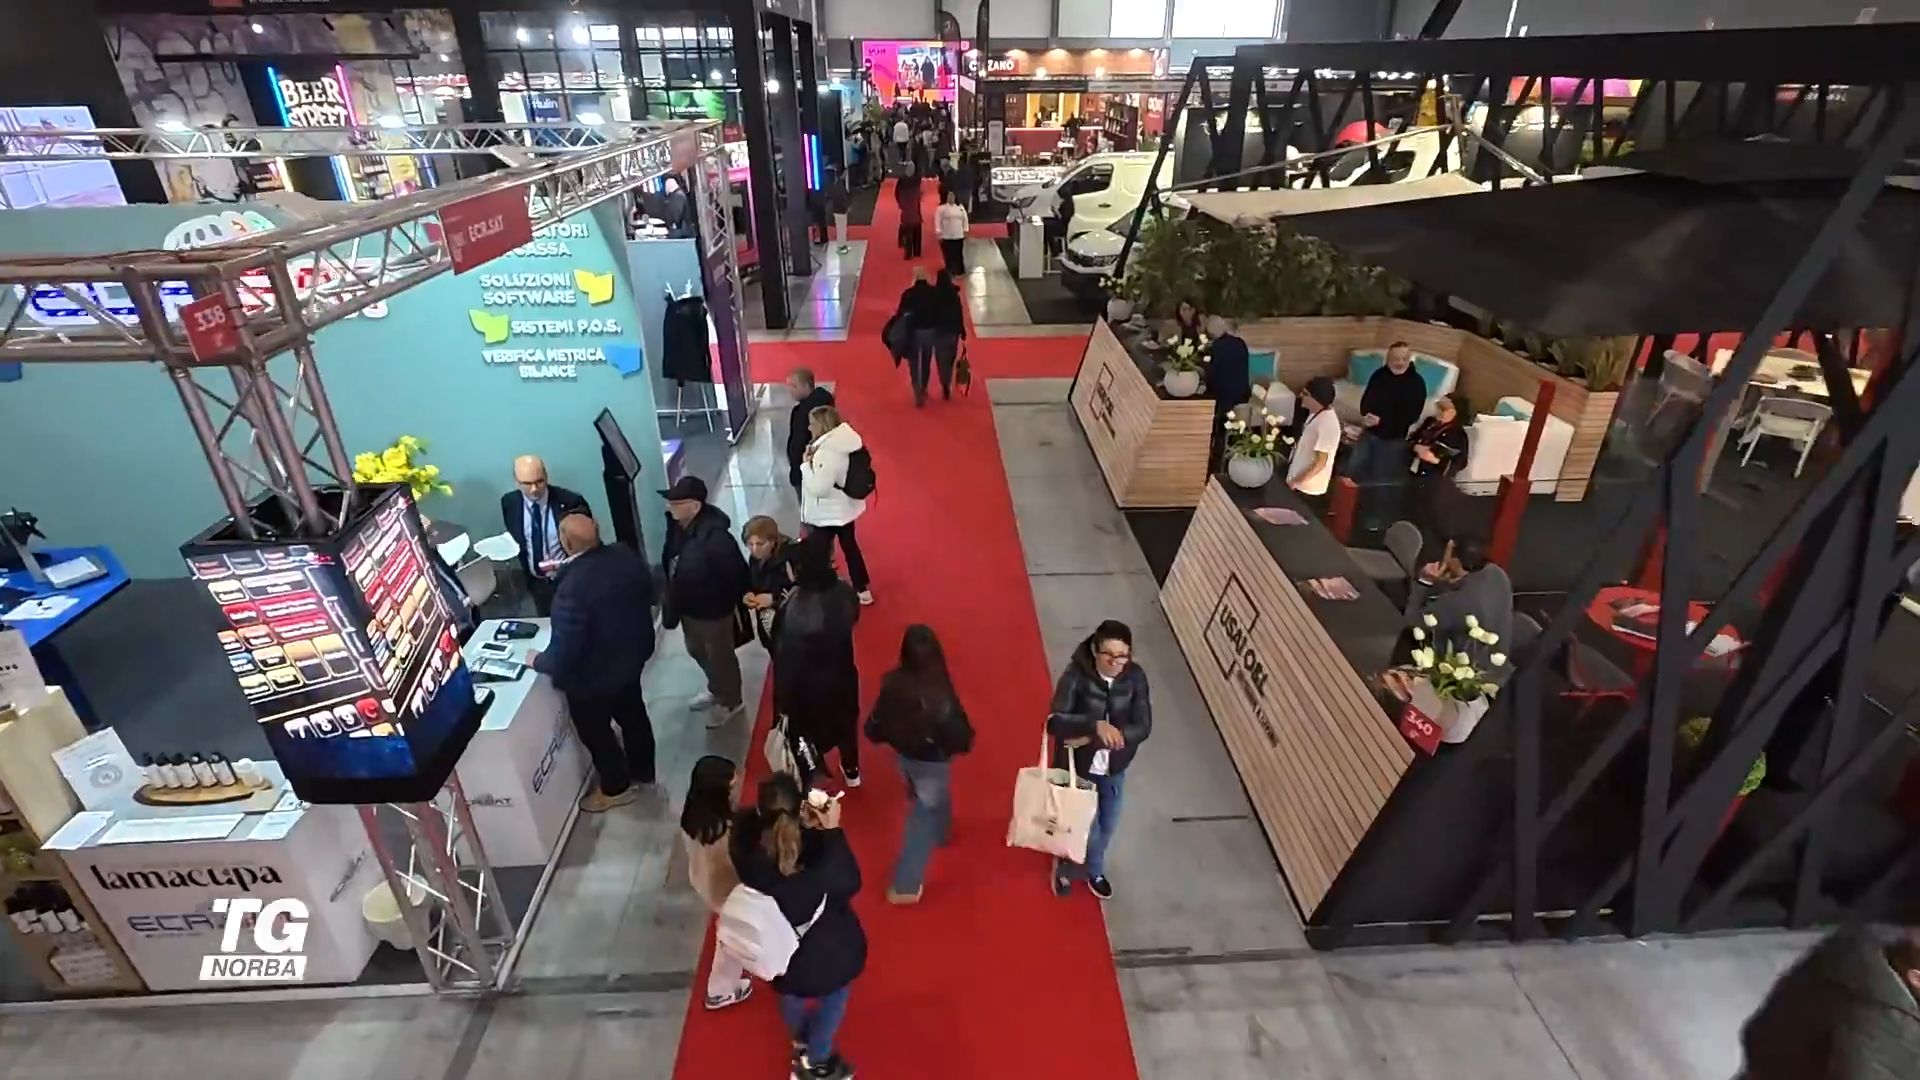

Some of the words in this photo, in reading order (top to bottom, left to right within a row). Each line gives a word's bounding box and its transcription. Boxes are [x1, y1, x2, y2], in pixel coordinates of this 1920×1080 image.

[279, 78, 343, 107] BEER
[287, 105, 348, 127] STREET
[533, 223, 588, 238] ATORI
[480, 274, 571, 288] SOLUZIONI
[483, 290, 576, 305] SOFTWARE
[194, 305, 226, 331] 338
[511, 320, 574, 335] SISTEMI
[577, 319, 622, 334] P.O.S.
[481, 350, 545, 364] VERIFICA
[546, 348, 606, 363] METRICA
[519, 364, 577, 378] BILANCE
[1407, 710, 1433, 736] 340
[90, 864, 282, 892] lamacupa
